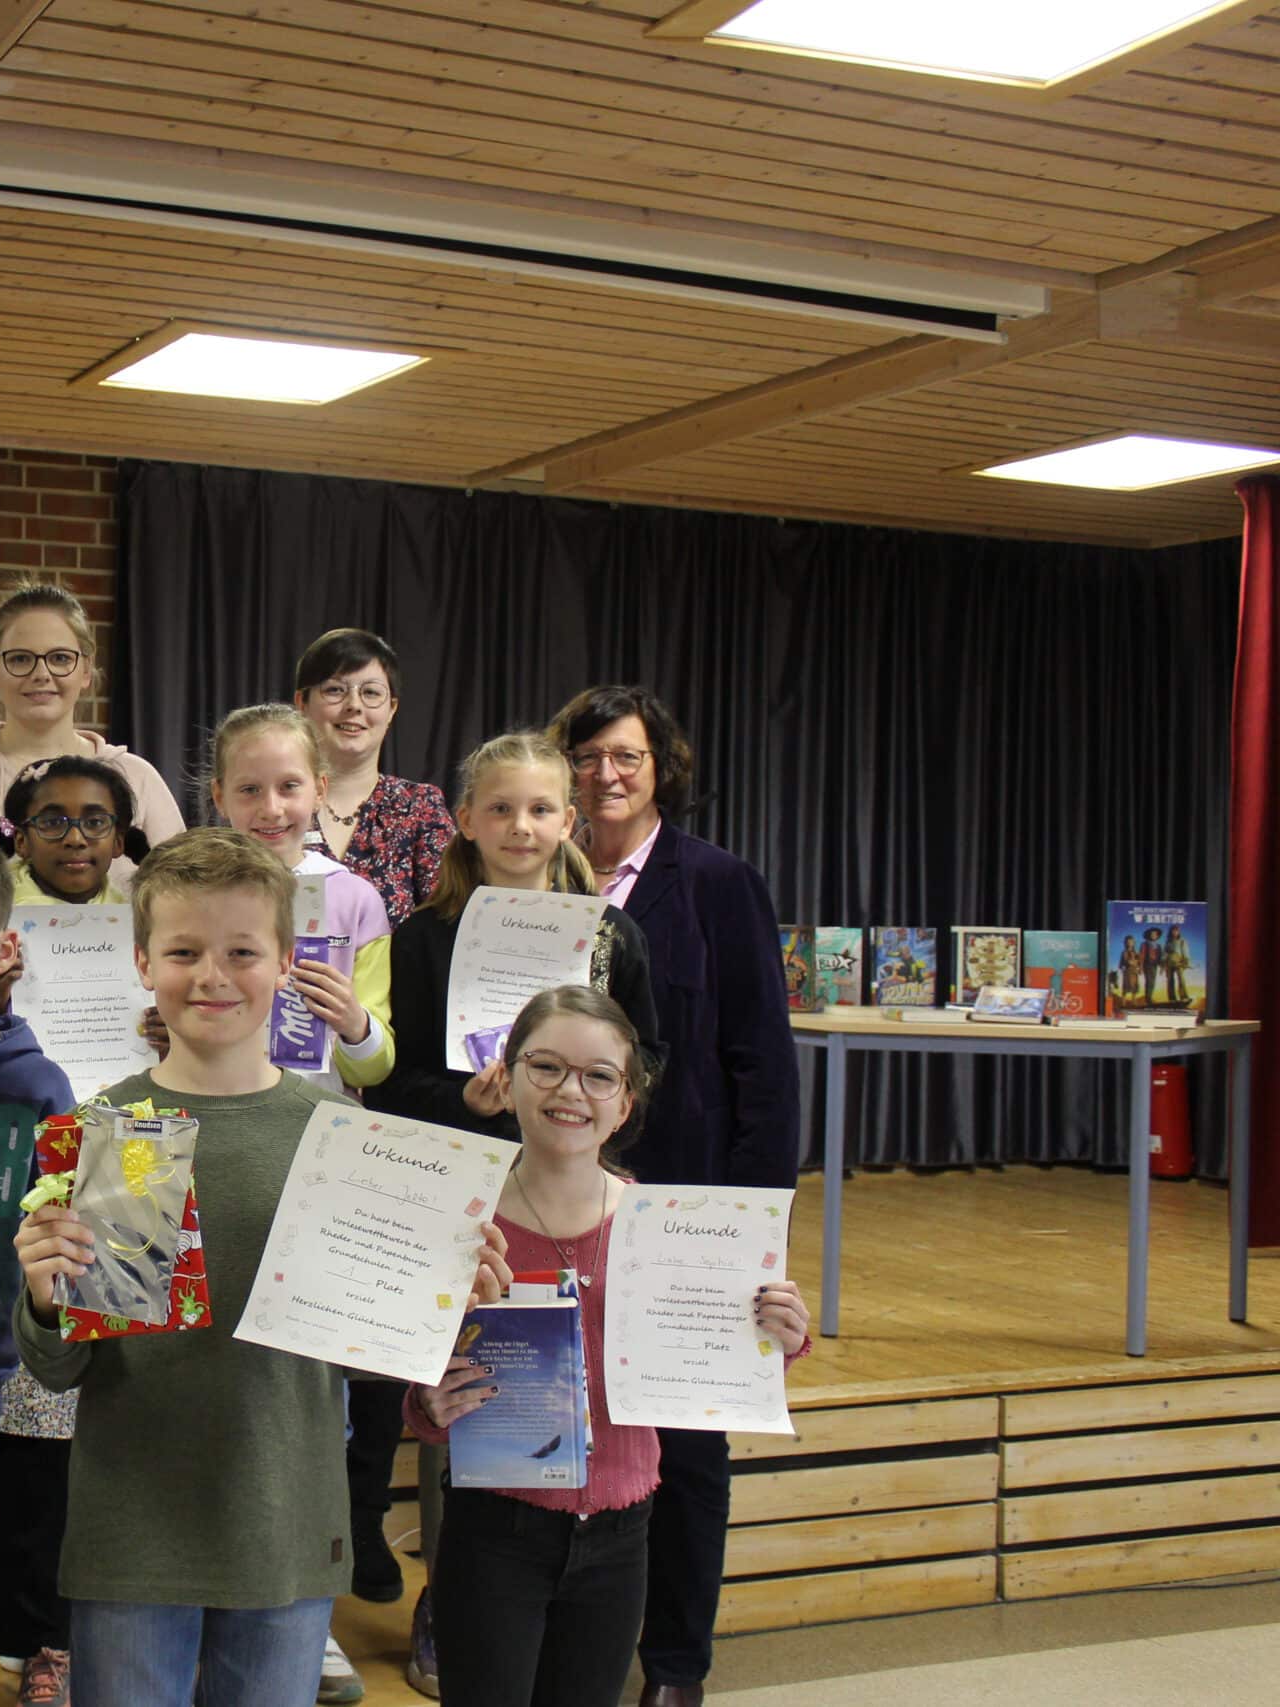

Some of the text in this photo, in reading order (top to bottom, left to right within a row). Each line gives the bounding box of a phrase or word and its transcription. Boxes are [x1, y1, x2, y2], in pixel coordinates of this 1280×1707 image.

[501, 916, 561, 934] Urkunde
[51, 942, 116, 955] Urkunde
[362, 1141, 450, 1176] Urkunde
[332, 1215, 428, 1252] Vorlesewettbewerb der
[392, 1220, 416, 1233] beim
[664, 1220, 741, 1238] Urkunde
[320, 1227, 433, 1268] Rheder und Papenburger
[328, 1246, 414, 1278] Grundschulen den
[376, 1279, 406, 1296] Platz
[292, 1294, 346, 1317] Herzlichen
[347, 1310, 417, 1336] Glückwunsch!
[704, 1341, 730, 1351] Platz
